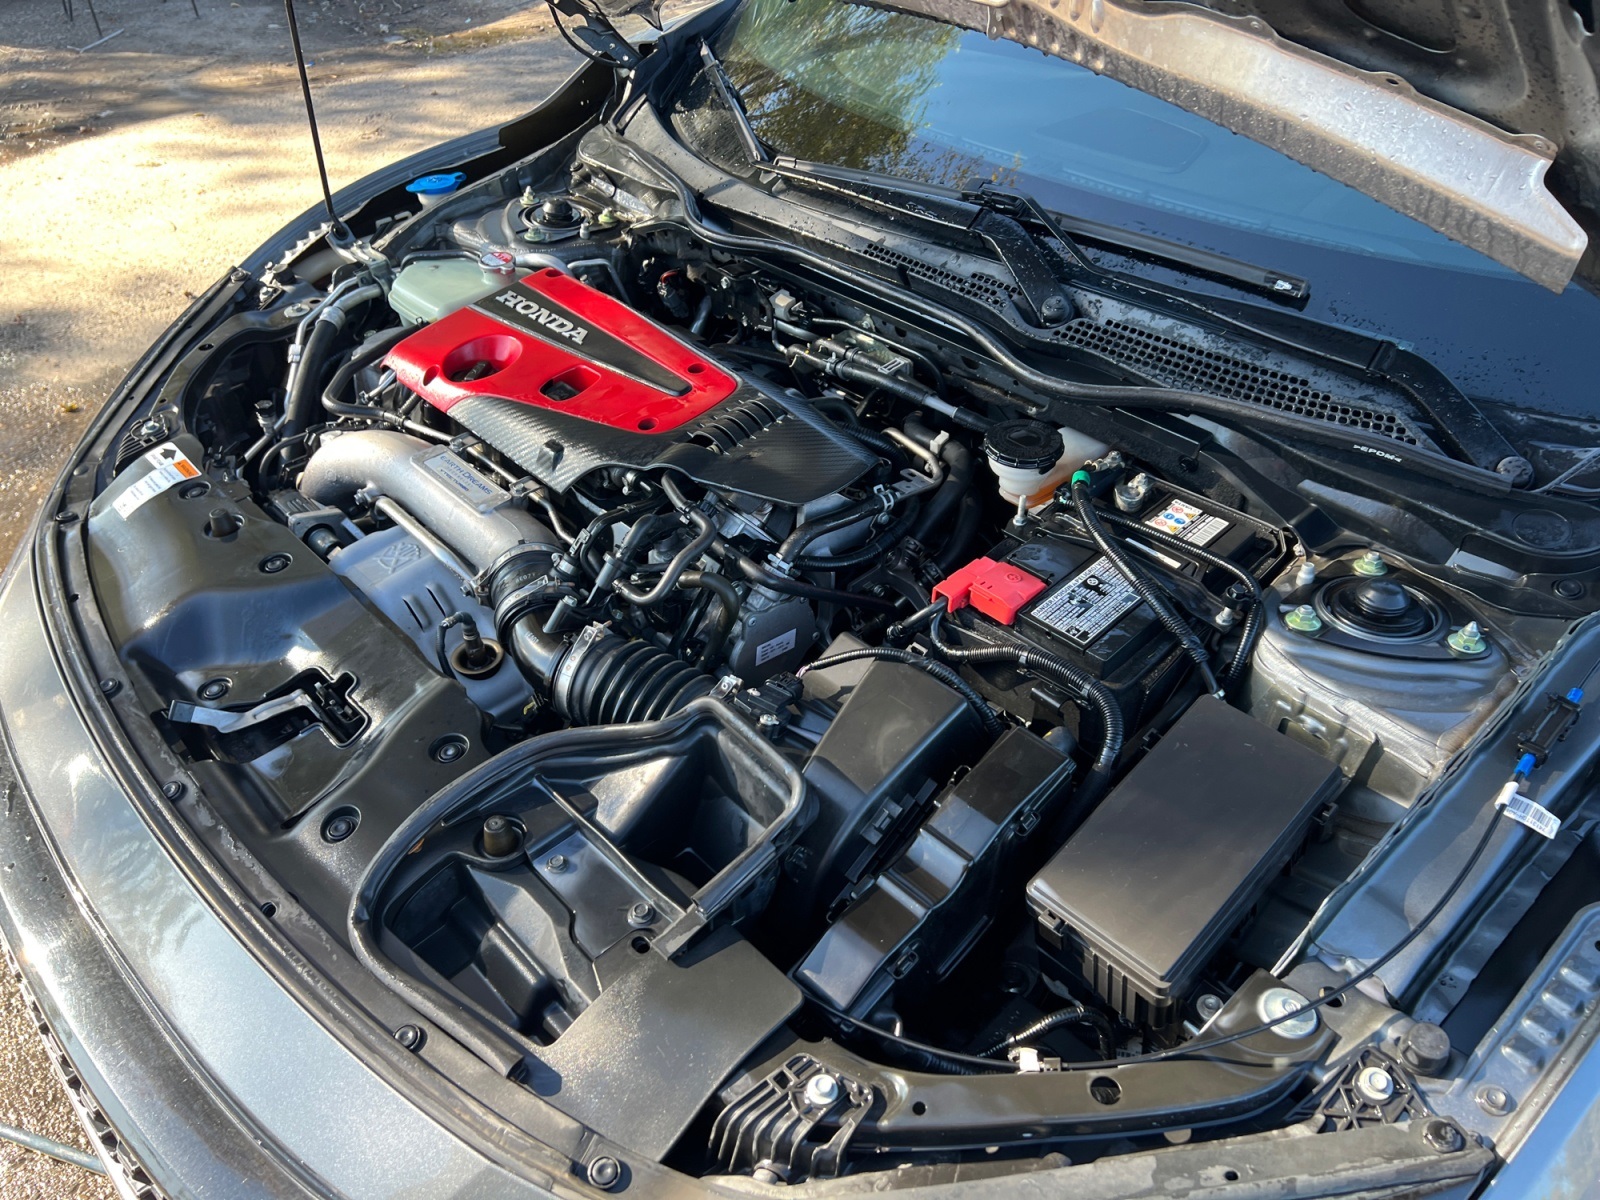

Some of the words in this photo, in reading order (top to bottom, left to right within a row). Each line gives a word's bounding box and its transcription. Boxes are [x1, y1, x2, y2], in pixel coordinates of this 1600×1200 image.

[495, 290, 588, 345] HONDA
[440, 455, 465, 474] EARTH
[462, 471, 493, 495] DREAMS
[1075, 556, 1108, 584] PELIGRO/VEN
